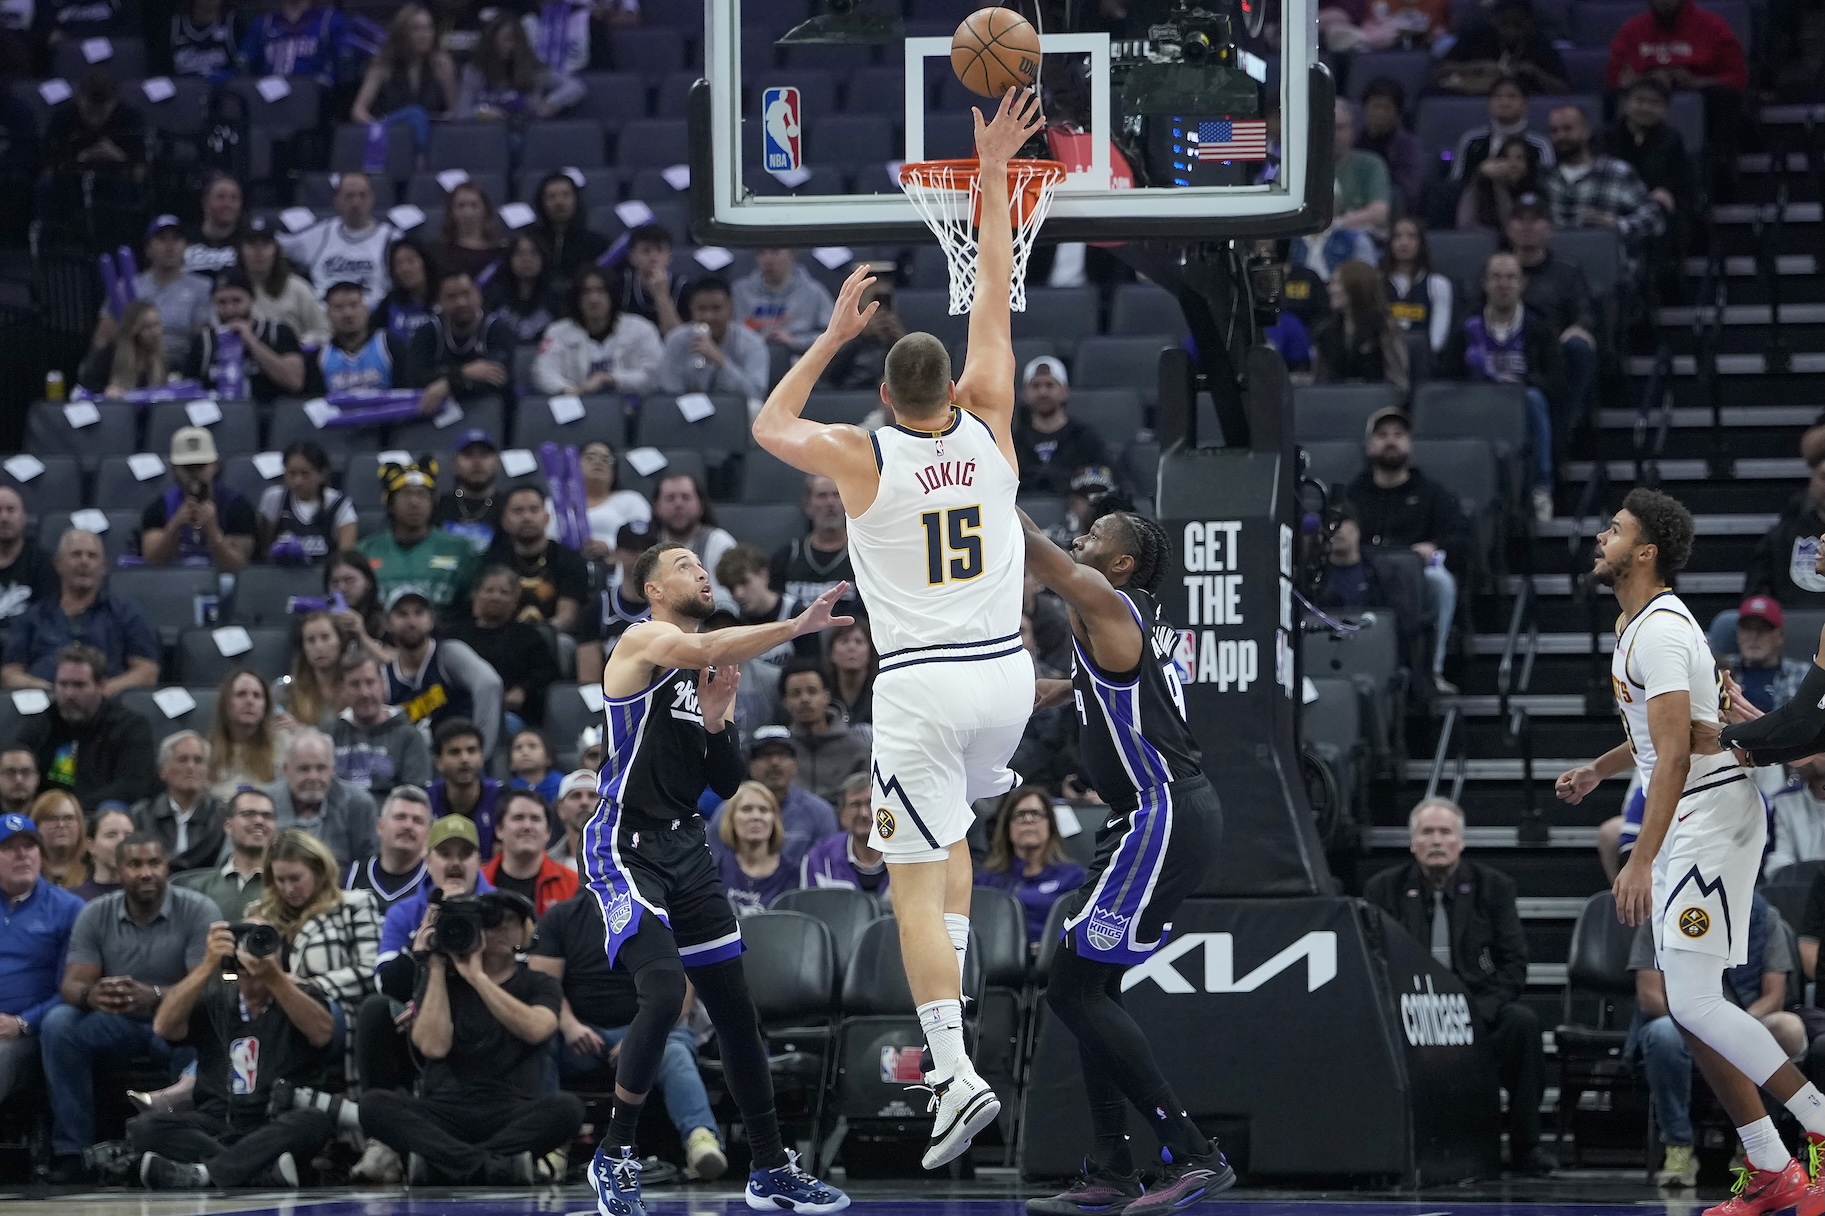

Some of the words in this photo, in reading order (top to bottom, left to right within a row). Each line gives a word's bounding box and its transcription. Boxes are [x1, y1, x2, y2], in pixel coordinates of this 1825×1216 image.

[769, 153, 788, 168] NBA
[914, 457, 976, 495] JOKIĆ
[920, 503, 984, 586] 15
[1183, 521, 1242, 572] GET
[1183, 575, 1244, 626] THE
[1198, 629, 1258, 692] App
[1089, 921, 1123, 939] KINGS
[1400, 973, 1474, 1047] coinbase
